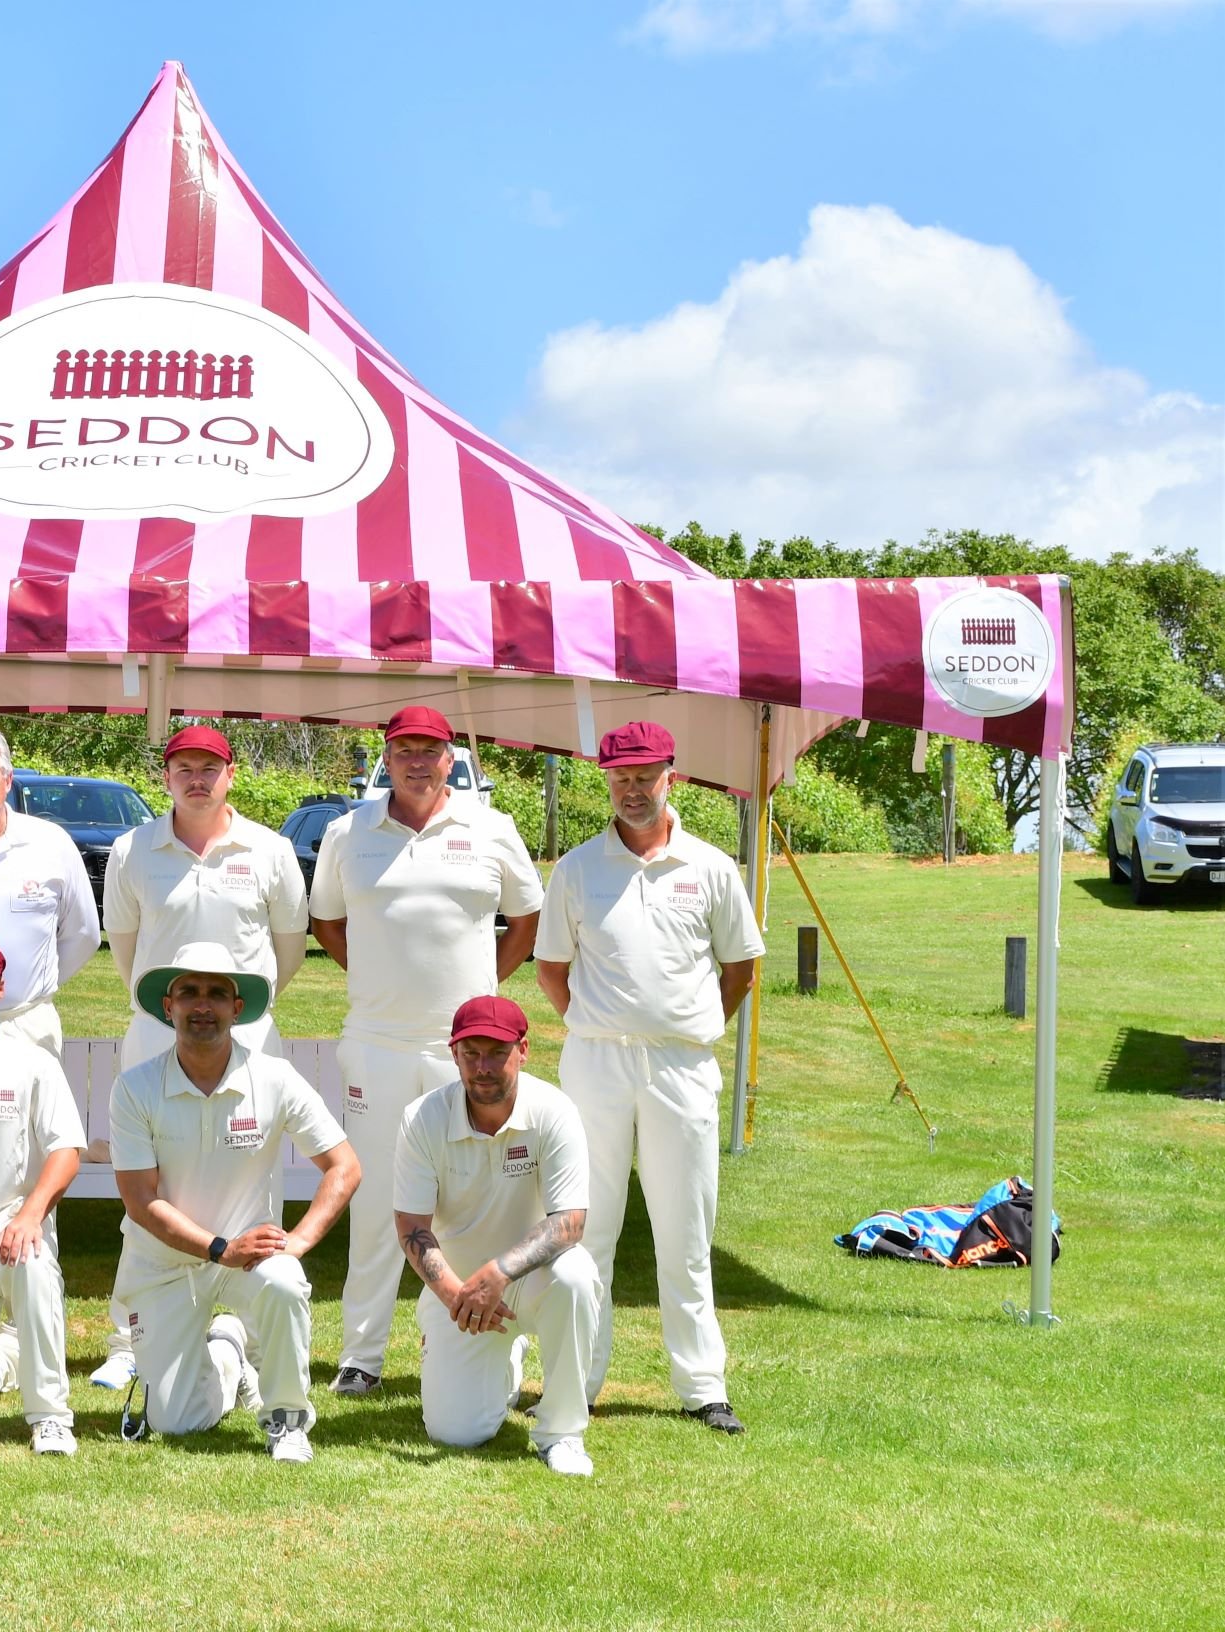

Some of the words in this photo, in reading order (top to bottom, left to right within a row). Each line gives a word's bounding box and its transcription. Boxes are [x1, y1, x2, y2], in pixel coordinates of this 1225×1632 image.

[38, 454, 165, 471] CRICKET
[174, 453, 249, 475] CLUB
[945, 655, 1035, 673] SEDDON
[962, 677, 996, 685] CRICKET
[997, 677, 1019, 685] CLUB
[219, 877, 256, 887] SEDDON
[666, 896, 705, 907] SEDDON
[224, 1132, 264, 1145] SEDDON
[502, 1160, 538, 1174] SEDDON
